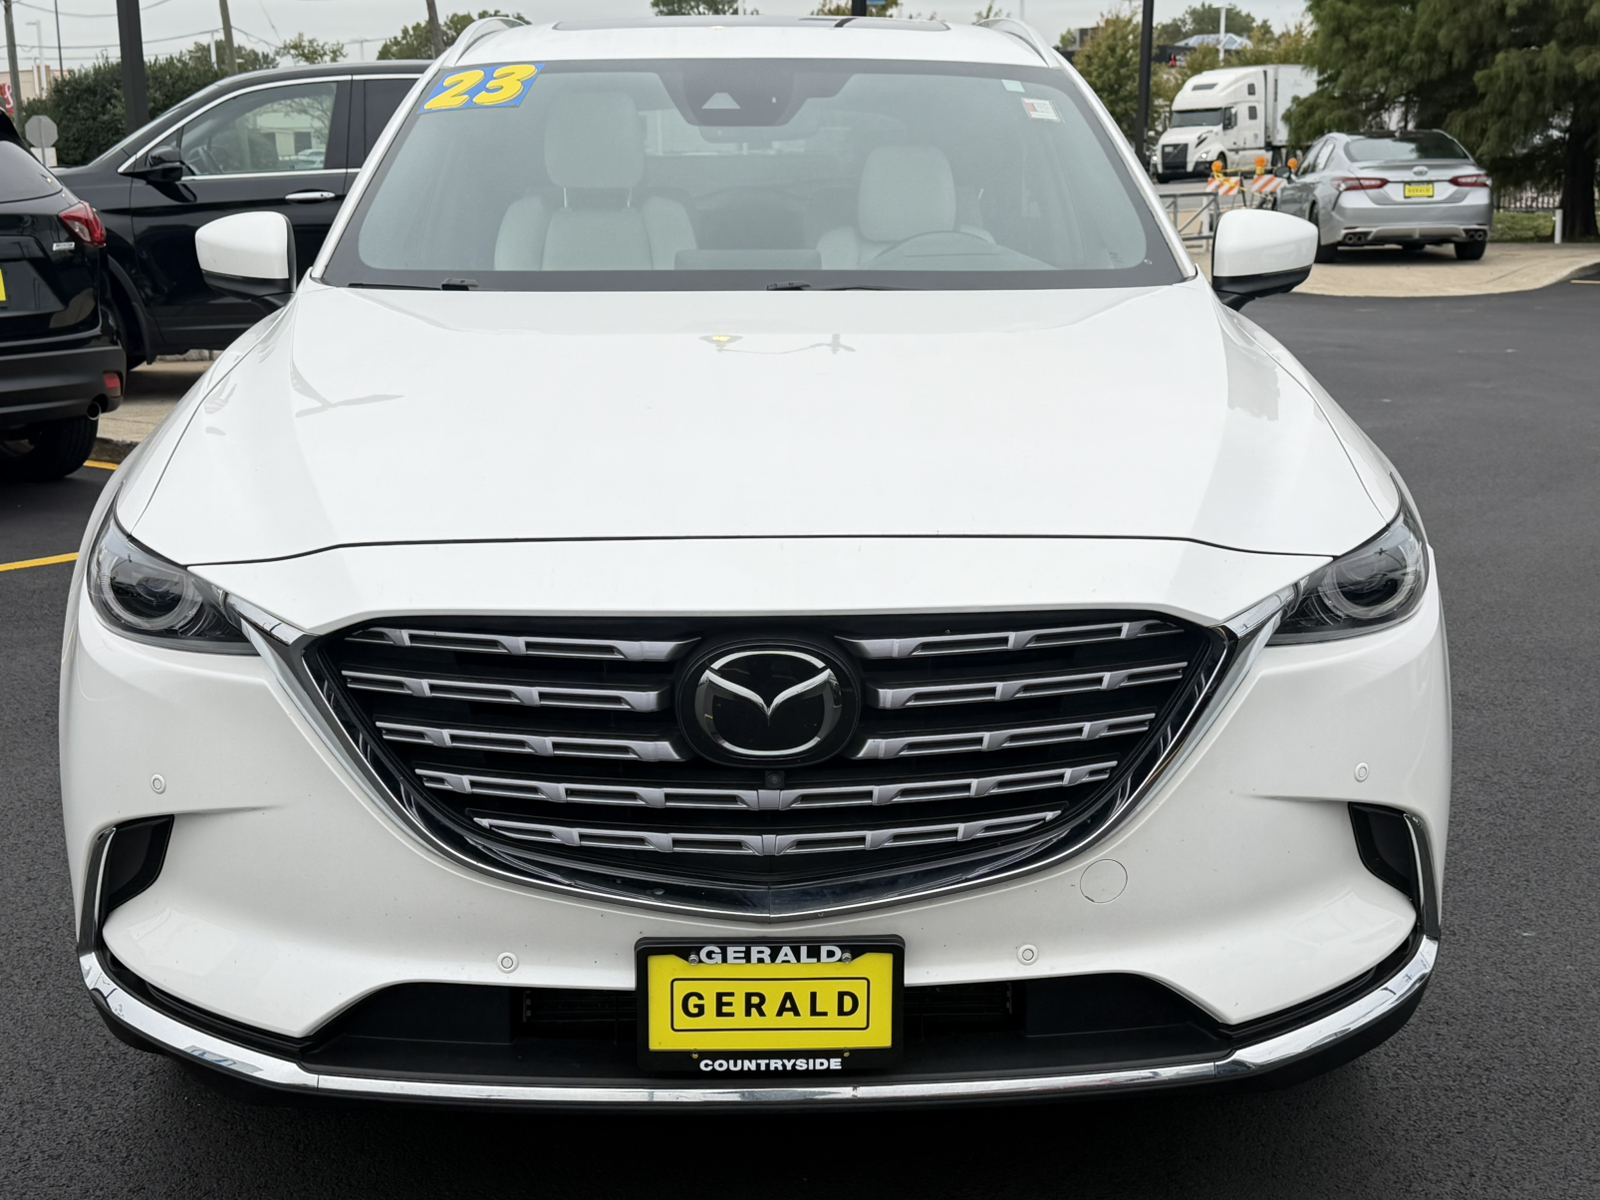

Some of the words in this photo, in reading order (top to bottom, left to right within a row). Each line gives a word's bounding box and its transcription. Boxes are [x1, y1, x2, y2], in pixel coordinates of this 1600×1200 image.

[424, 64, 538, 110] 23
[699, 945, 842, 964] GERALD
[681, 991, 859, 1018] GERALD
[699, 1058, 842, 1071] COUNTRYSIDE
